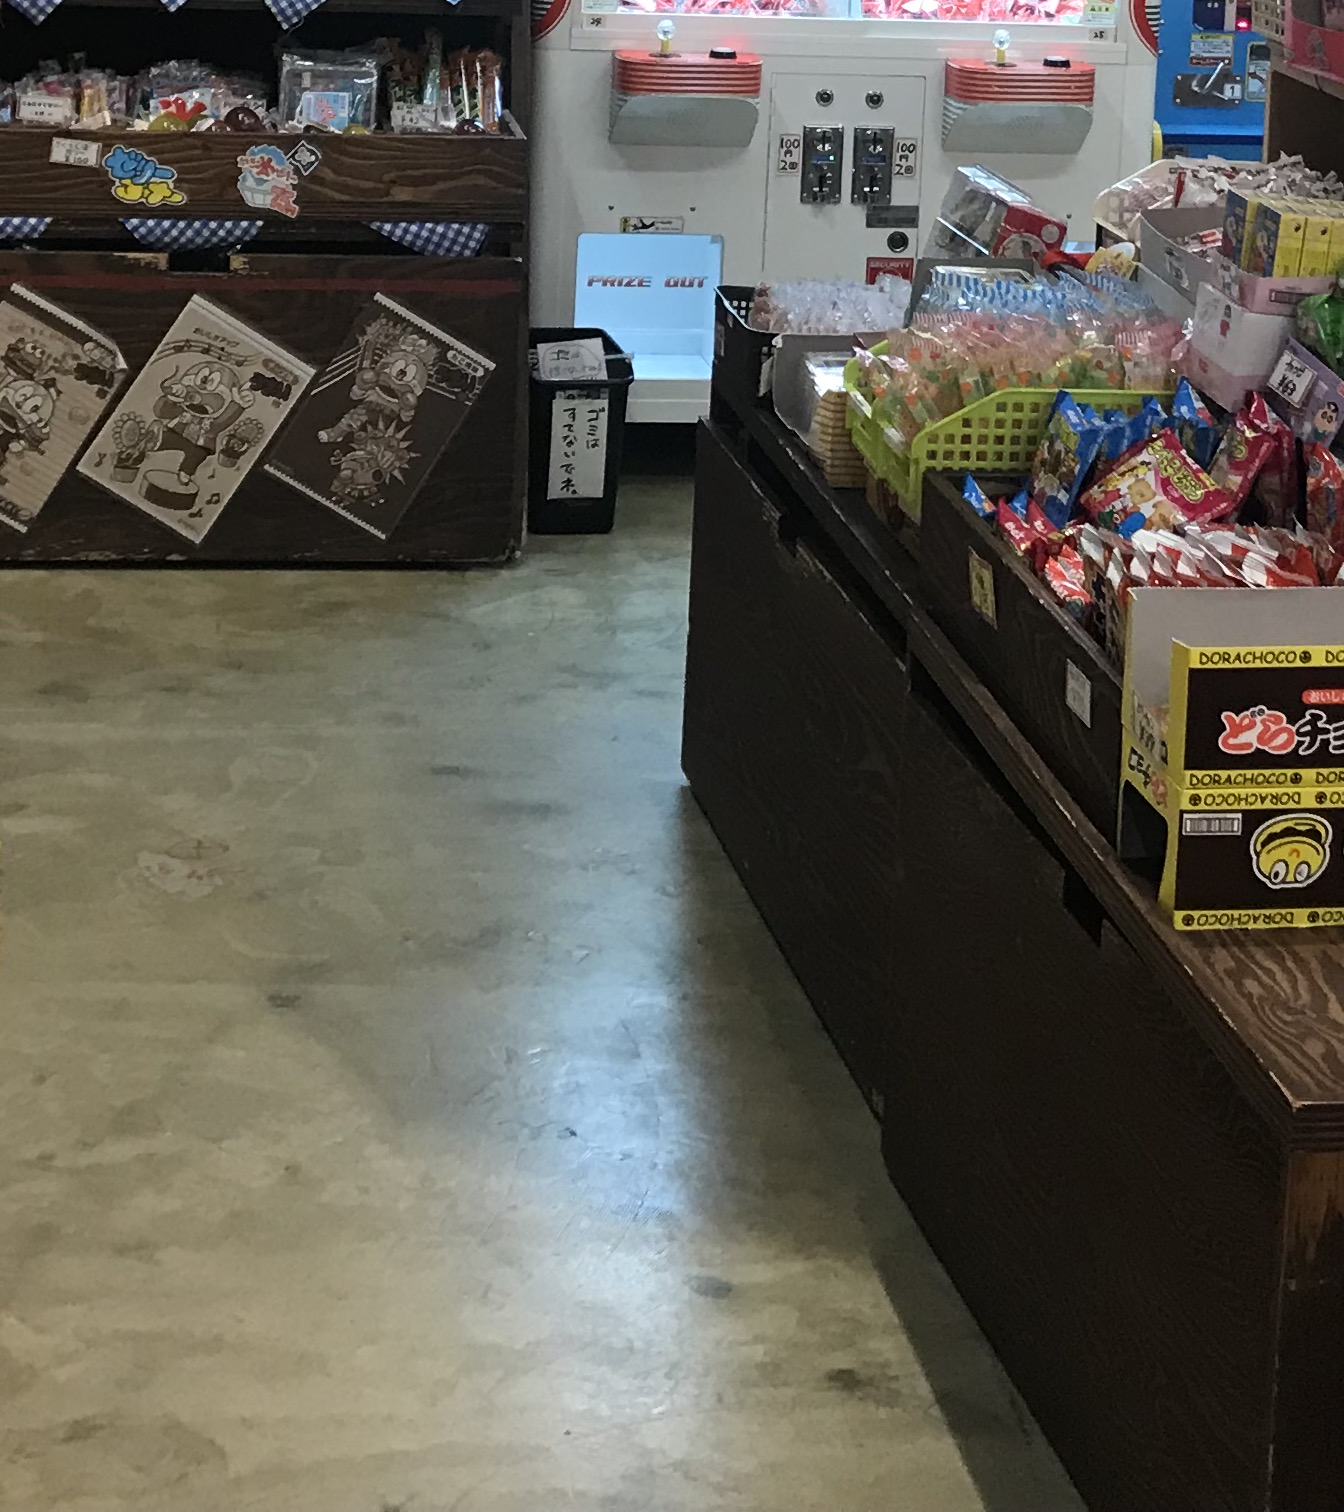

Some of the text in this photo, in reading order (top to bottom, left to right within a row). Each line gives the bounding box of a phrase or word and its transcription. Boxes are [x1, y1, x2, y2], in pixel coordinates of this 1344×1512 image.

[1093, 30, 1105, 39] 25
[779, 137, 801, 149] 100
[896, 141, 917, 154] 100
[587, 274, 709, 288] PRIZE OUT
[585, 406, 606, 449] ゴミは
[1198, 649, 1298, 666] DORACHOCO
[1188, 771, 1289, 787] DORACHOCO
[1203, 792, 1302, 807] DORACHOCO
[1196, 910, 1295, 927] DORACHOCO
